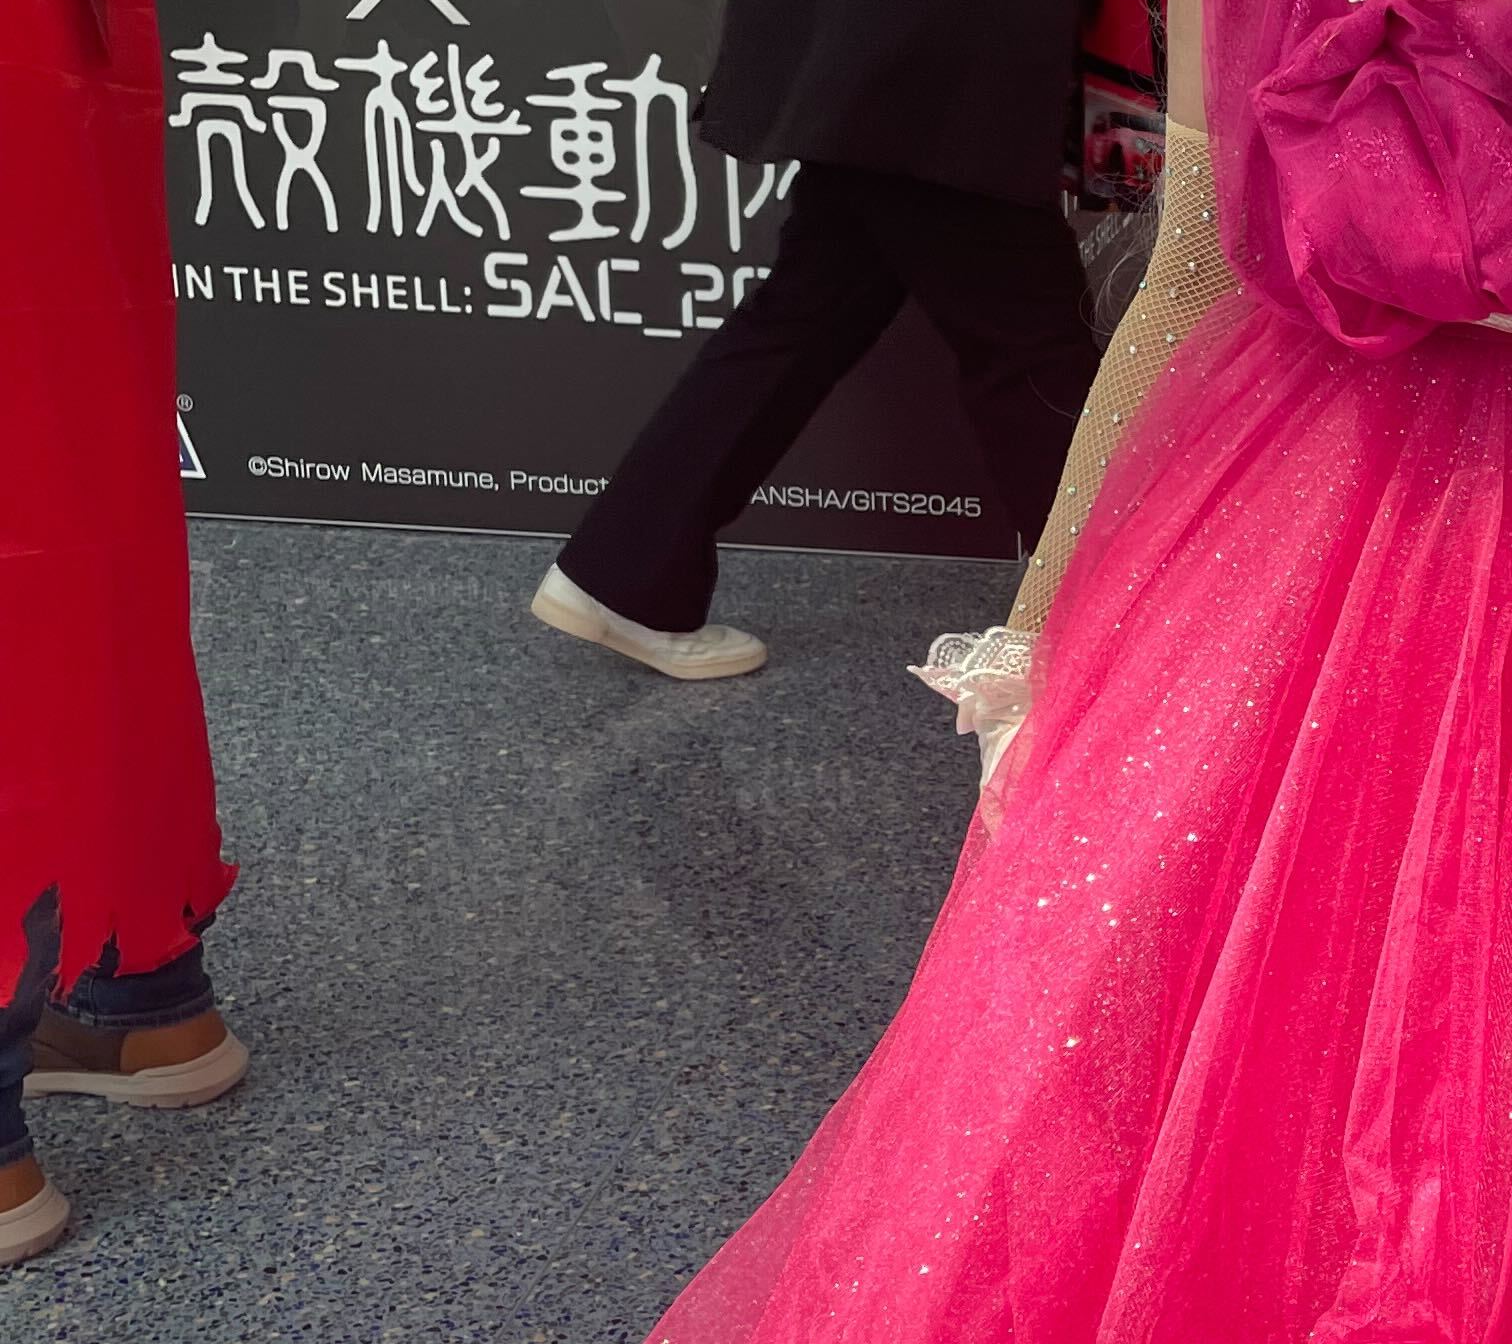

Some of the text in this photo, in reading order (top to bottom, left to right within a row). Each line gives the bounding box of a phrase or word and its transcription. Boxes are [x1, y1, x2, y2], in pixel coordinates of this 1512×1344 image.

[168, 31, 801, 253] 殻機動
[172, 262, 214, 300] IN
[223, 266, 310, 307] THE
[324, 271, 474, 314] SHELL:
[361, 462, 500, 492] Masamune,
[509, 470, 609, 496] Product
[750, 485, 982, 517] ANSHA/GITS2045
